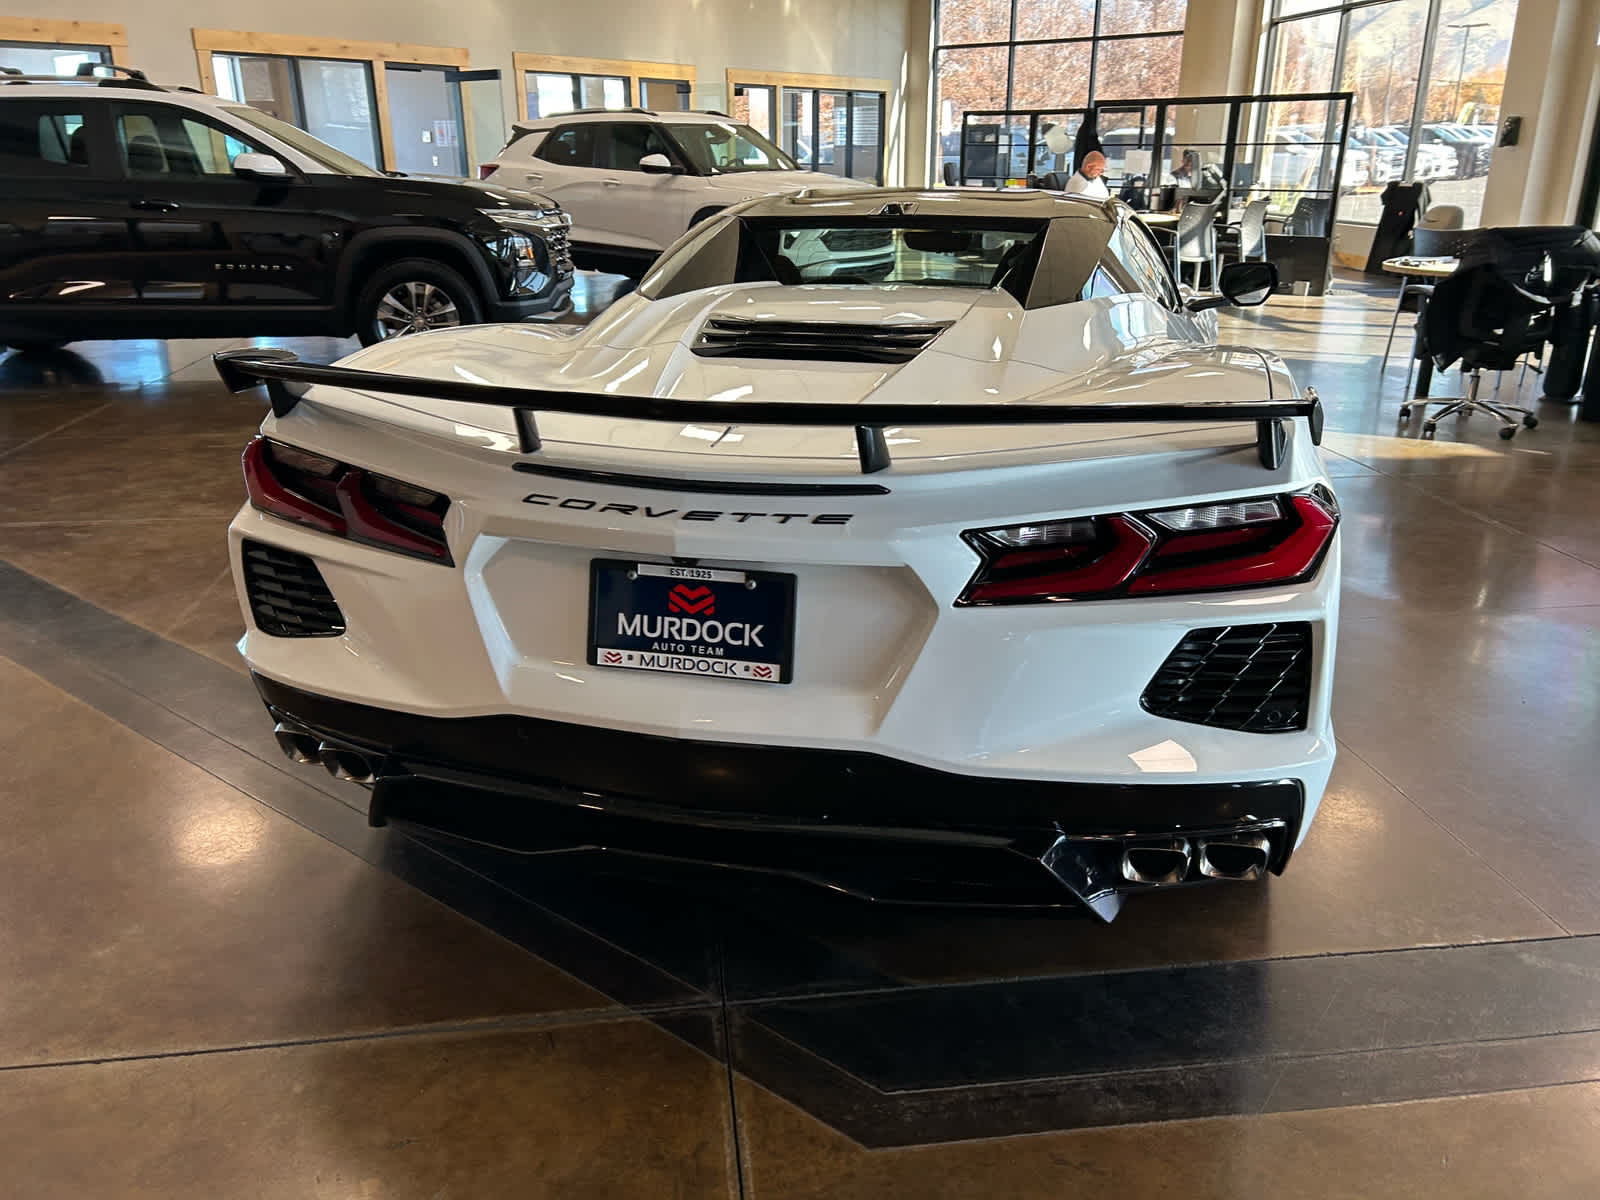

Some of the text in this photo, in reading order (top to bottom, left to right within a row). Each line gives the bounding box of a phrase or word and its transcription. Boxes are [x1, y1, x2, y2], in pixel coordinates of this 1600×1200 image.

[522, 493, 854, 525] CORVETTE
[670, 568, 712, 579] EST. 1925
[617, 612, 764, 648] MURDOCK
[651, 641, 724, 656] AUTO TEAM
[639, 653, 737, 676] MURDOCK
